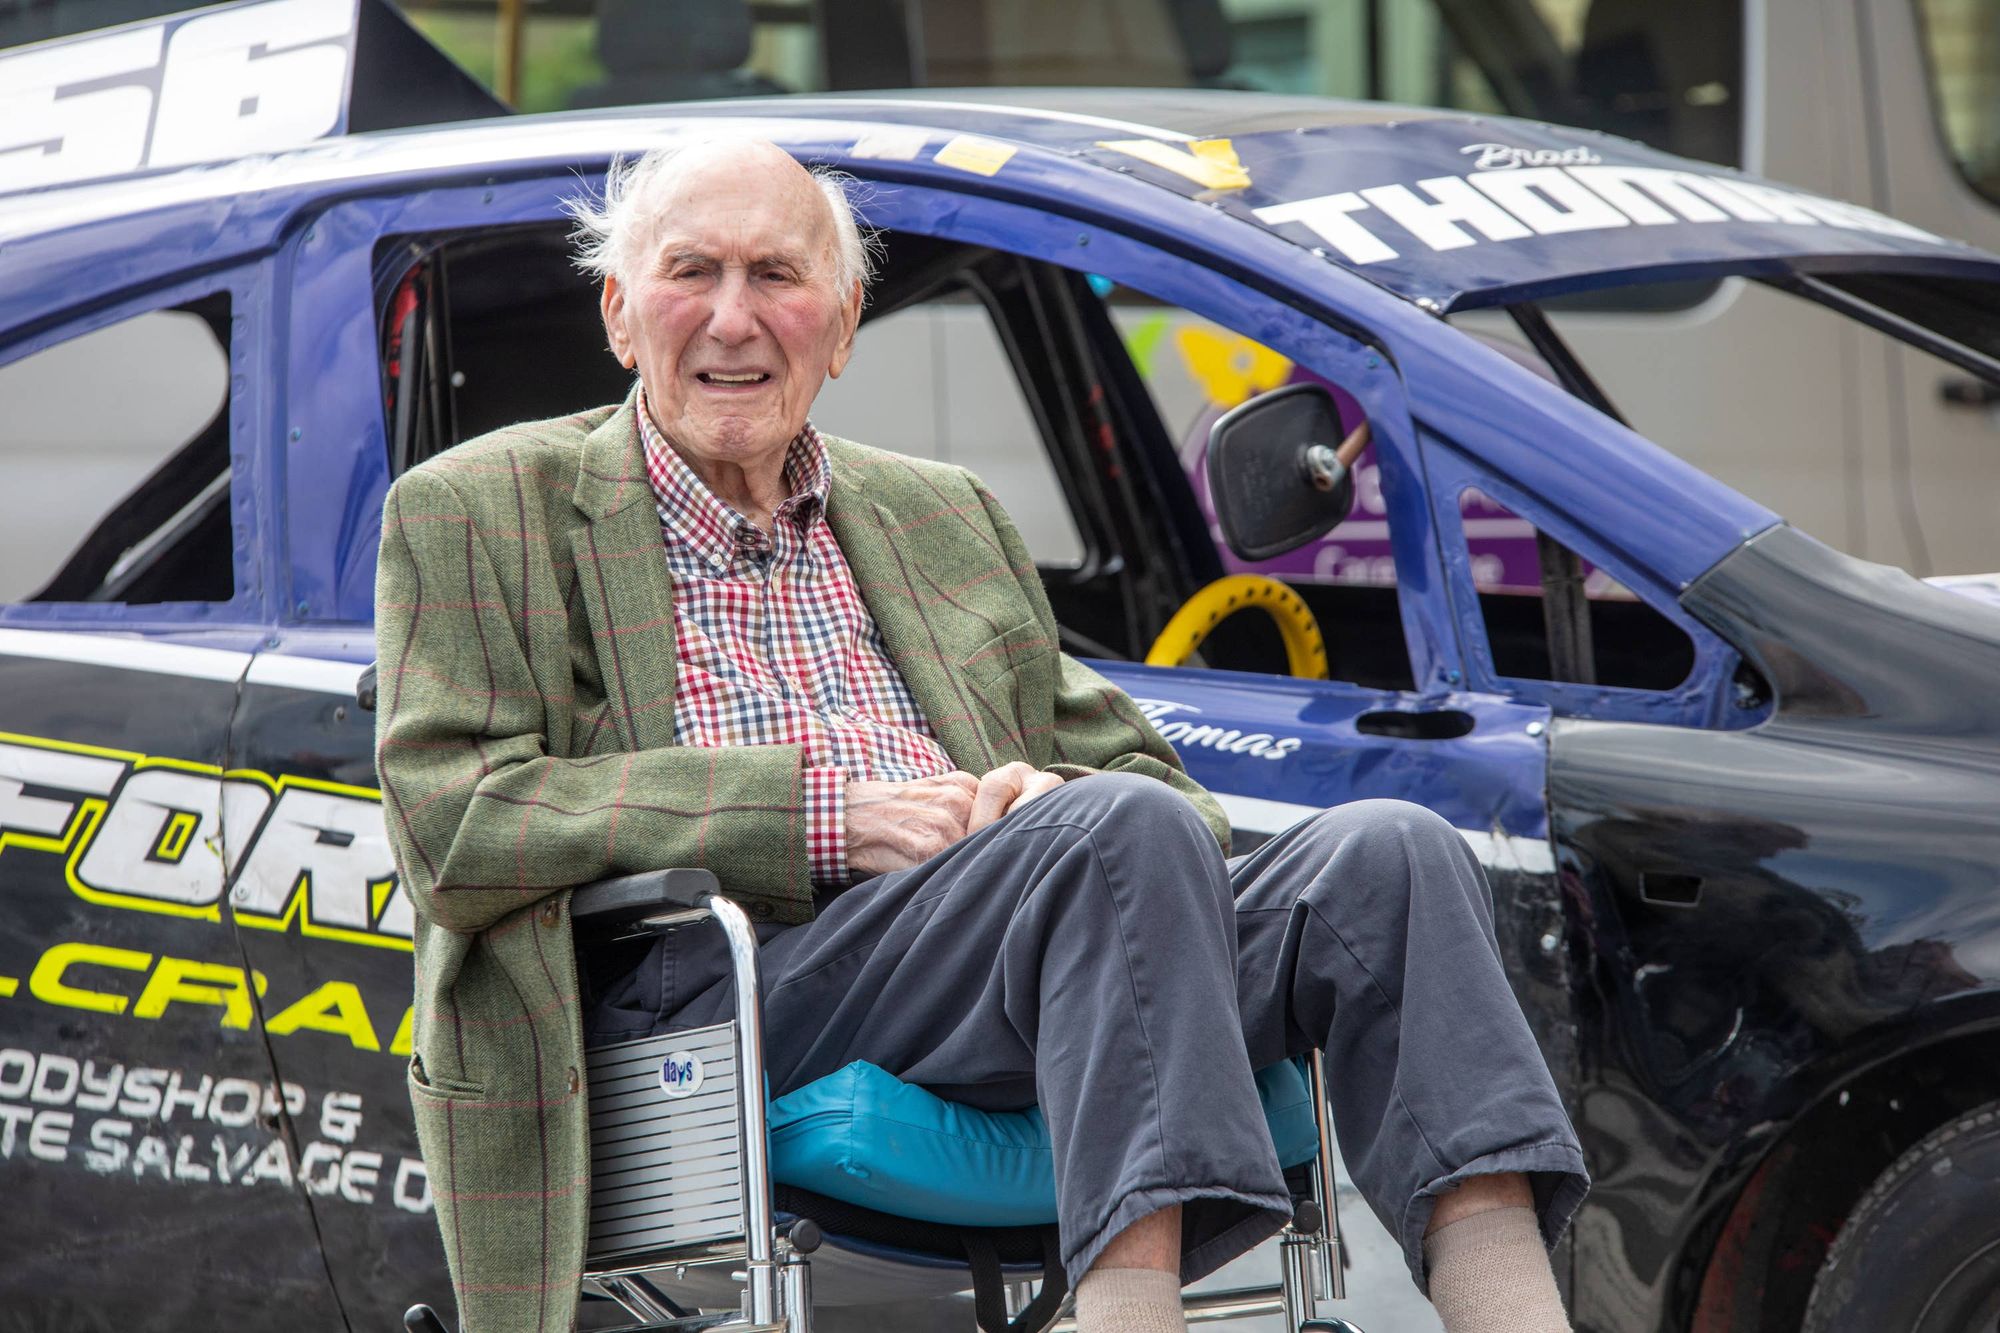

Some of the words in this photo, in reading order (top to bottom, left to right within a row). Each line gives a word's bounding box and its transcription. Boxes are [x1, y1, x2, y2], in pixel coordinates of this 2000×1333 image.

[663, 1058, 693, 1087] days
[319, 1090, 363, 1144] &
[84, 1118, 383, 1204] SALVAGE
